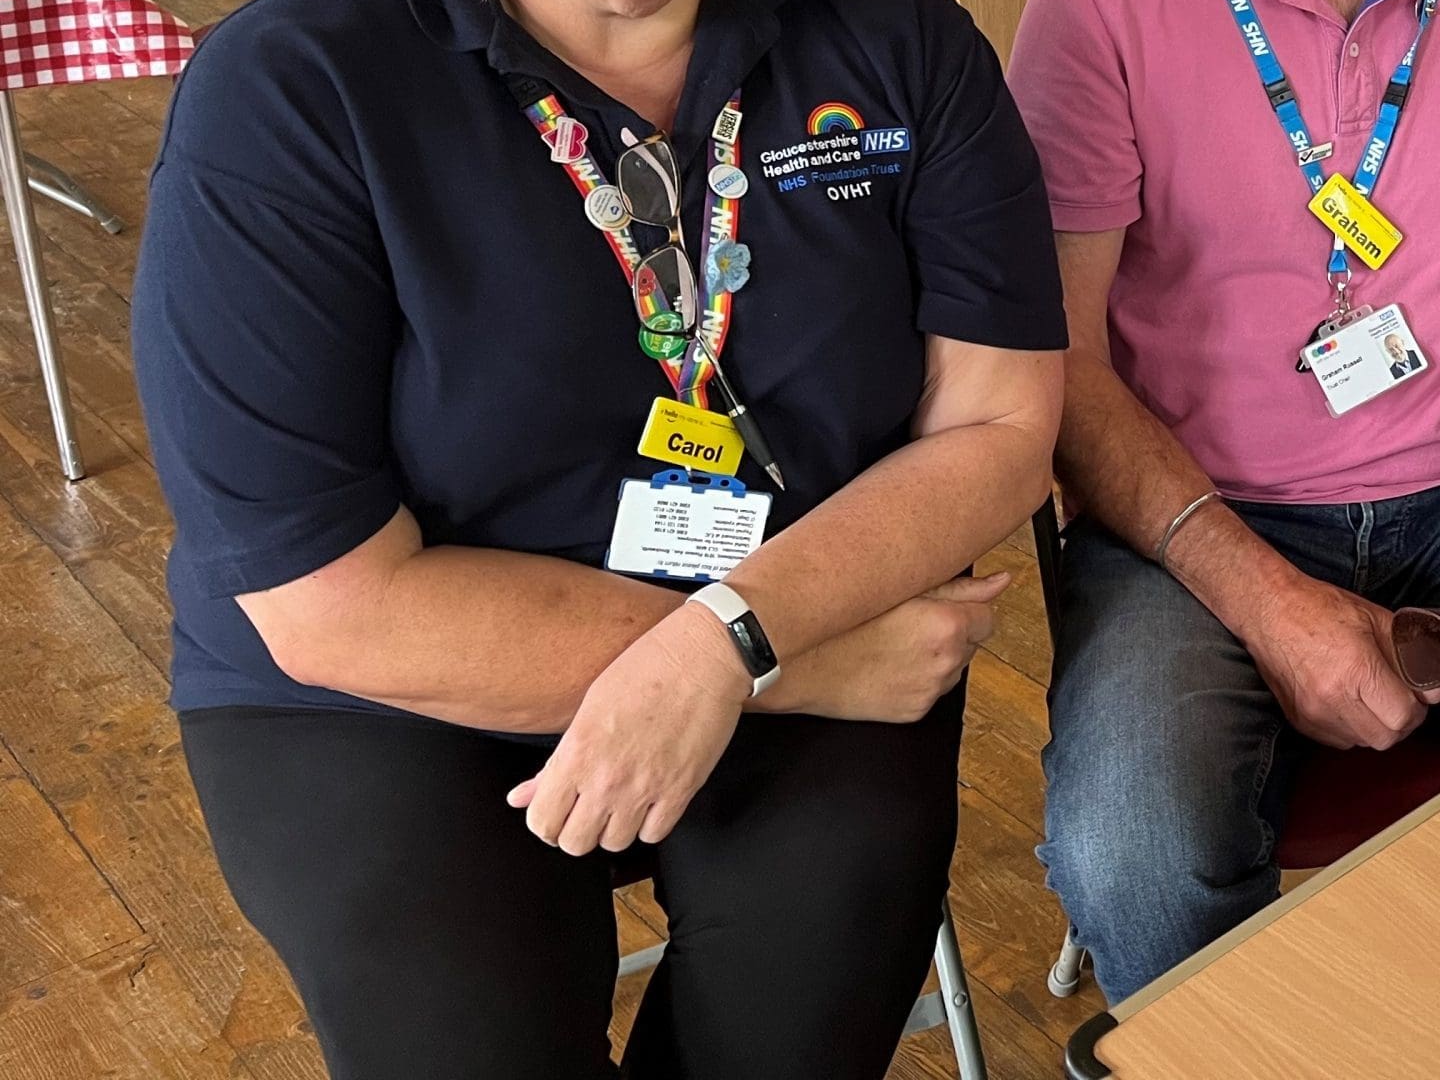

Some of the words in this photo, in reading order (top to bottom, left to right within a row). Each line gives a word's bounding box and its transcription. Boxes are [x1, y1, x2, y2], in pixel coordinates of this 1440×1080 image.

[1242, 21, 1269, 57] NHS
[760, 133, 860, 164] Gloucestershire
[864, 131, 906, 151] NHS
[1361, 137, 1386, 175] NHS
[763, 157, 810, 178] Health
[810, 154, 832, 166] and
[832, 150, 861, 163] Care
[778, 176, 808, 192] NHS
[811, 165, 869, 184] Foundation
[870, 163, 902, 175] Trust
[826, 181, 872, 201] OVHT
[1321, 197, 1382, 260] Graham
[1321, 367, 1342, 382] Graham
[1343, 356, 1363, 370] Russell
[667, 432, 724, 463] Carol
